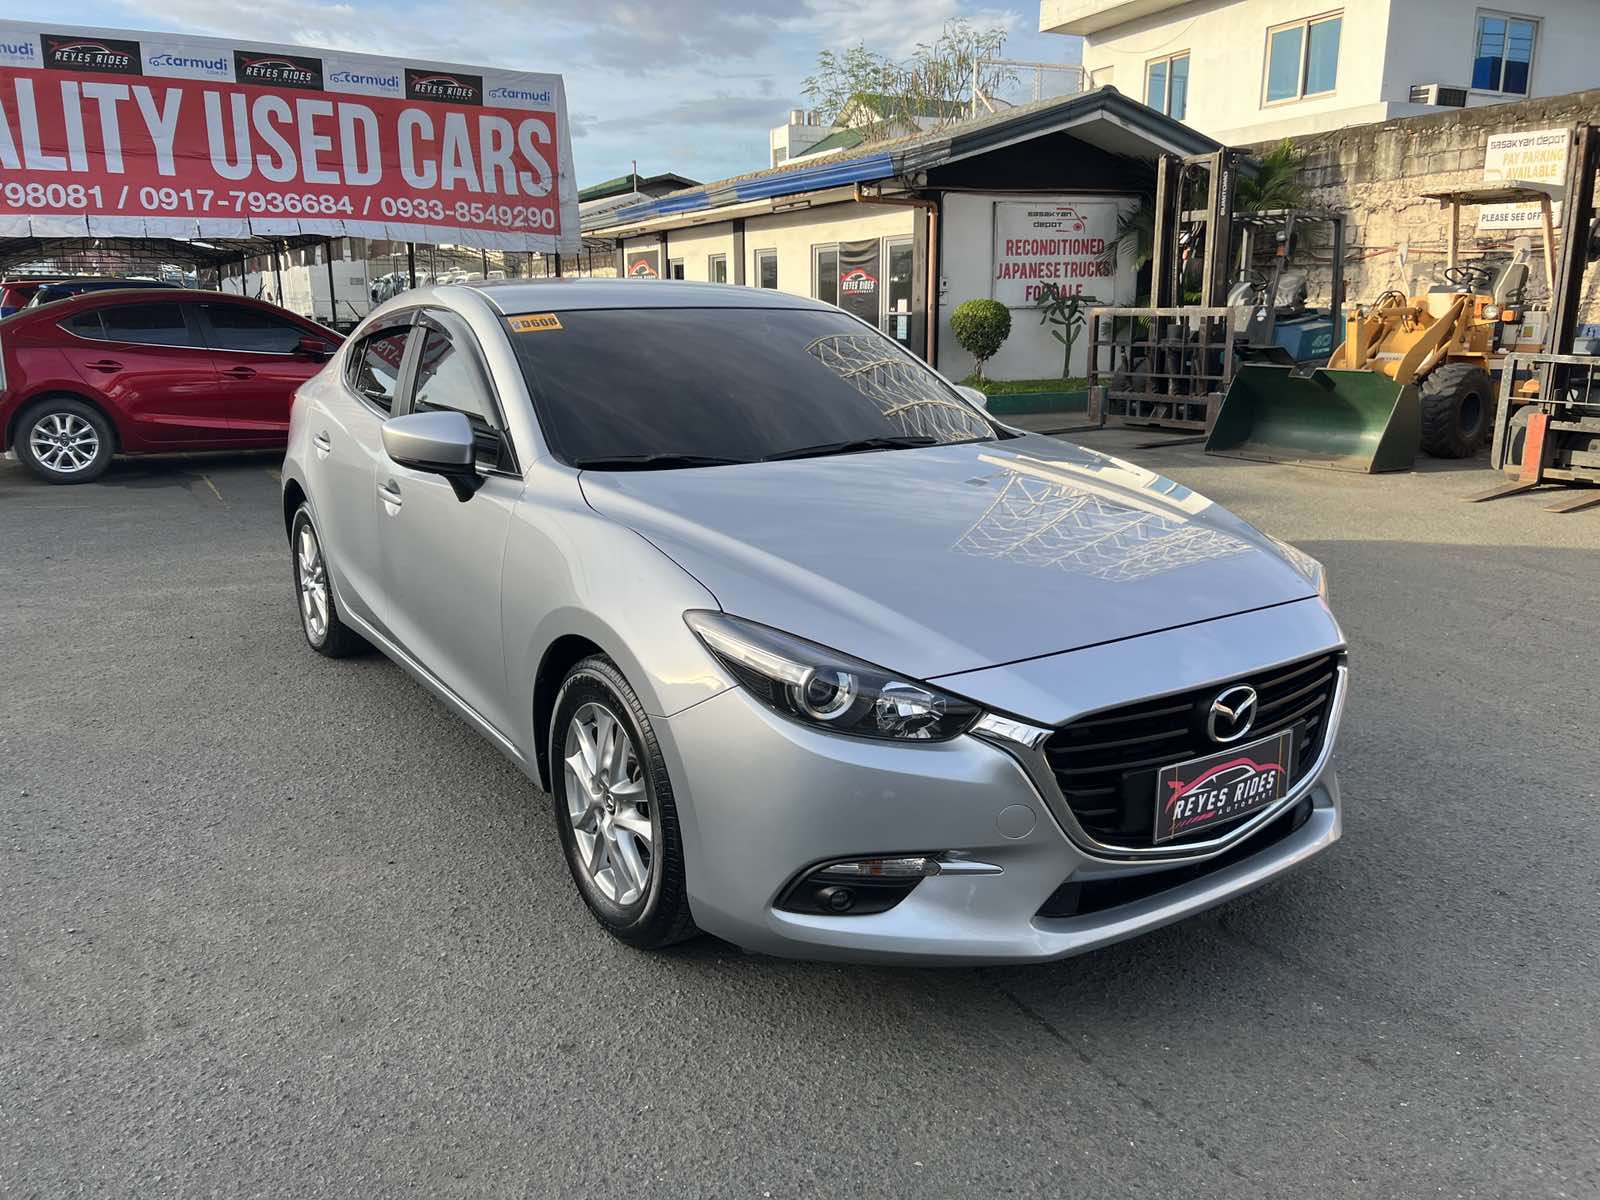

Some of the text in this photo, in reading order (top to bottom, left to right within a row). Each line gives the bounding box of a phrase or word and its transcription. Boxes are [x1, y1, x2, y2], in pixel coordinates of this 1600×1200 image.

[55, 51, 129, 65] REYES RIDES
[166, 56, 228, 71] carmudi
[246, 66, 312, 81] REYES RIDES
[345, 73, 399, 88] carmudi
[415, 83, 473, 97] REYES RIDES
[502, 90, 550, 102] carmudi
[203, 90, 382, 185] USED
[397, 107, 552, 198] CARS
[1522, 148, 1565, 164] PARKING
[1506, 164, 1558, 180] AVAILABLE
[0, 182, 104, 209] 98081
[139, 187, 354, 215] 0917-7936684
[380, 196, 556, 229] 0933-8549290
[1481, 213, 1509, 222] PLEASE
[1511, 212, 1526, 221] SEE
[1006, 239, 1105, 256] RECONDITIONED
[997, 261, 1060, 279] JAPANESE
[1173, 770, 1276, 821] REYES RIDES
